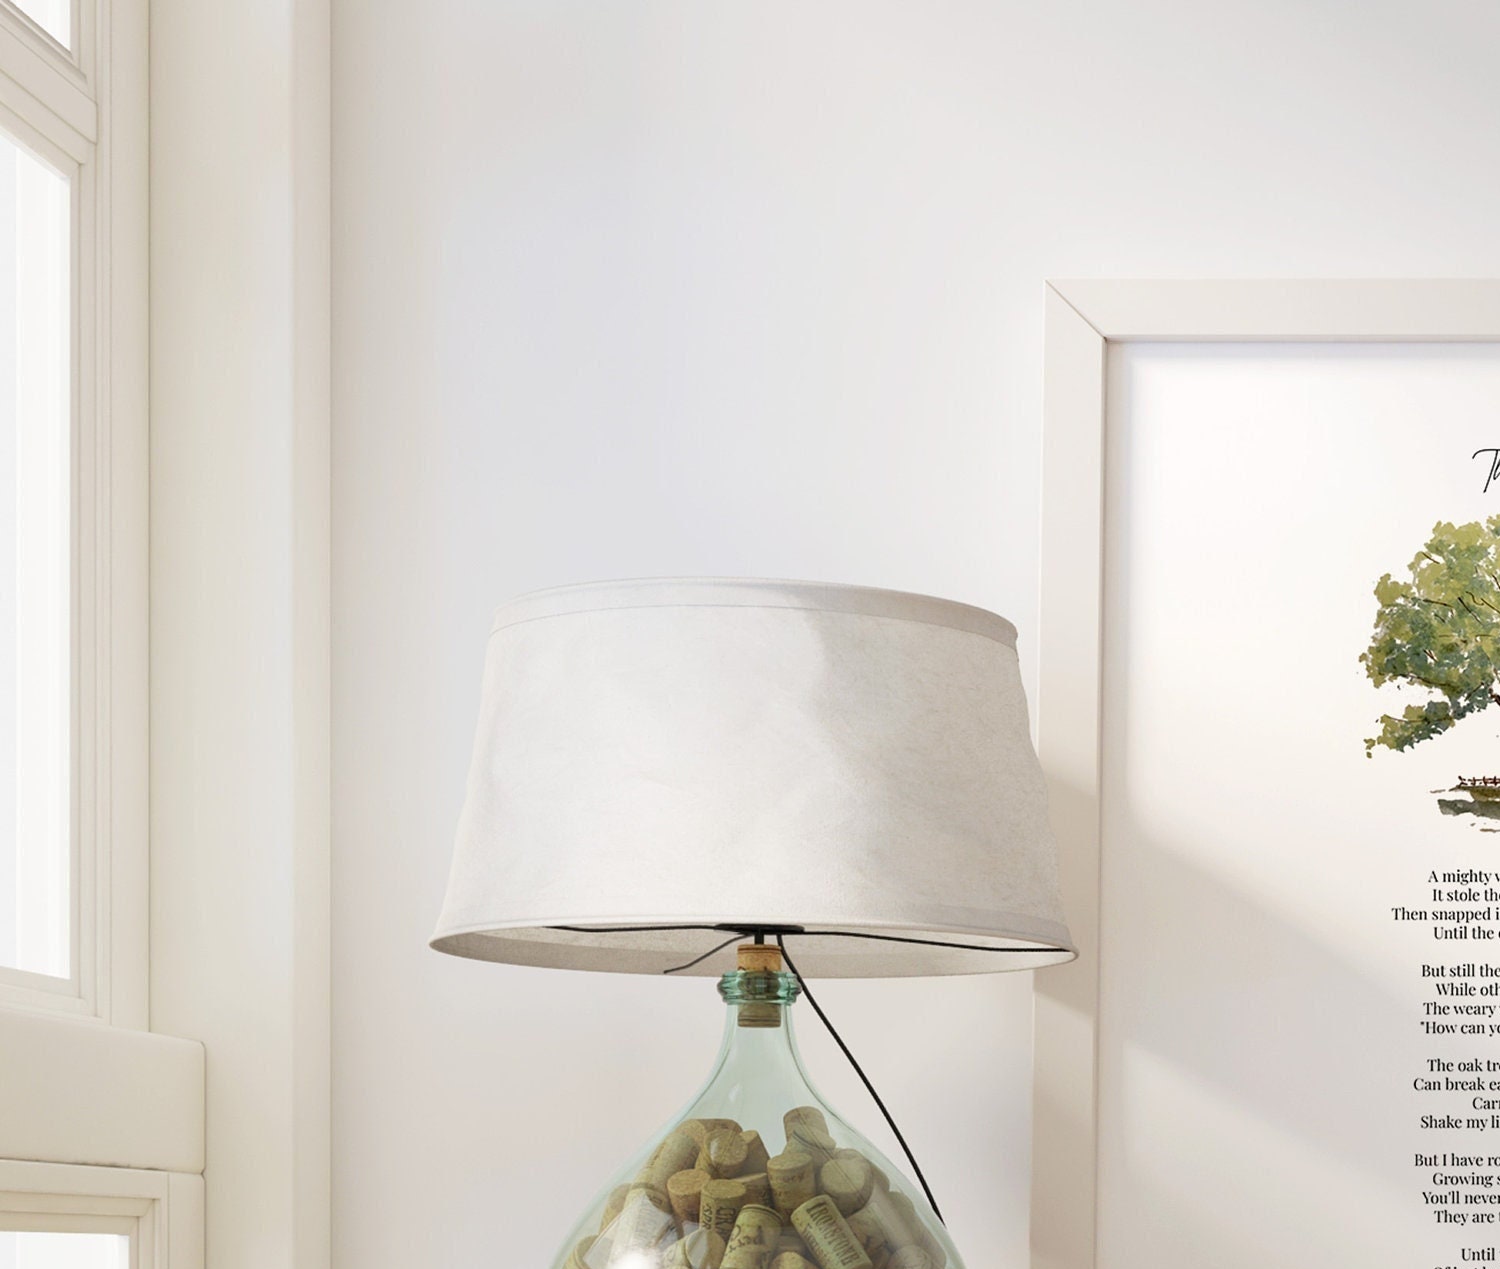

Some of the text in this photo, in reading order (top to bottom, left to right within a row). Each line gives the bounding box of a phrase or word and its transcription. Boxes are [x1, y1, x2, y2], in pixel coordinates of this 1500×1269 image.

[1427, 870, 1439, 883] A
[1442, 868, 1492, 886] mighty
[1433, 888, 1443, 902] It
[1446, 887, 1481, 902] stole
[1391, 906, 1428, 921] Then
[1431, 906, 1491, 924] snapped
[1433, 925, 1468, 940] Until
[1471, 925, 1495, 940] the
[1422, 964, 1446, 978] But
[1449, 963, 1475, 978] still
[1435, 982, 1477, 997] While
[1422, 1001, 1451, 1016] The
[1453, 1005, 1497, 1019] weary
[1420, 1021, 1458, 1035] "How
[1460, 1024, 1486, 1035] can
[1426, 1057, 1454, 1073] The
[1457, 1057, 1483, 1073] oak
[1413, 1077, 1442, 1091] Can
[1445, 1076, 1486, 1092] break
[1420, 1114, 1463, 1130] Shake
[1466, 1118, 1489, 1132] my
[1414, 1153, 1439, 1167] But
[1442, 1153, 1447, 1167] I
[1451, 1152, 1484, 1167] have
[1432, 1171, 1494, 1189] Growing
[1421, 1190, 1460, 1205] You'll
[1433, 1209, 1469, 1227] They
[1471, 1213, 1495, 1224] are
[1461, 1247, 1496, 1262] Until
